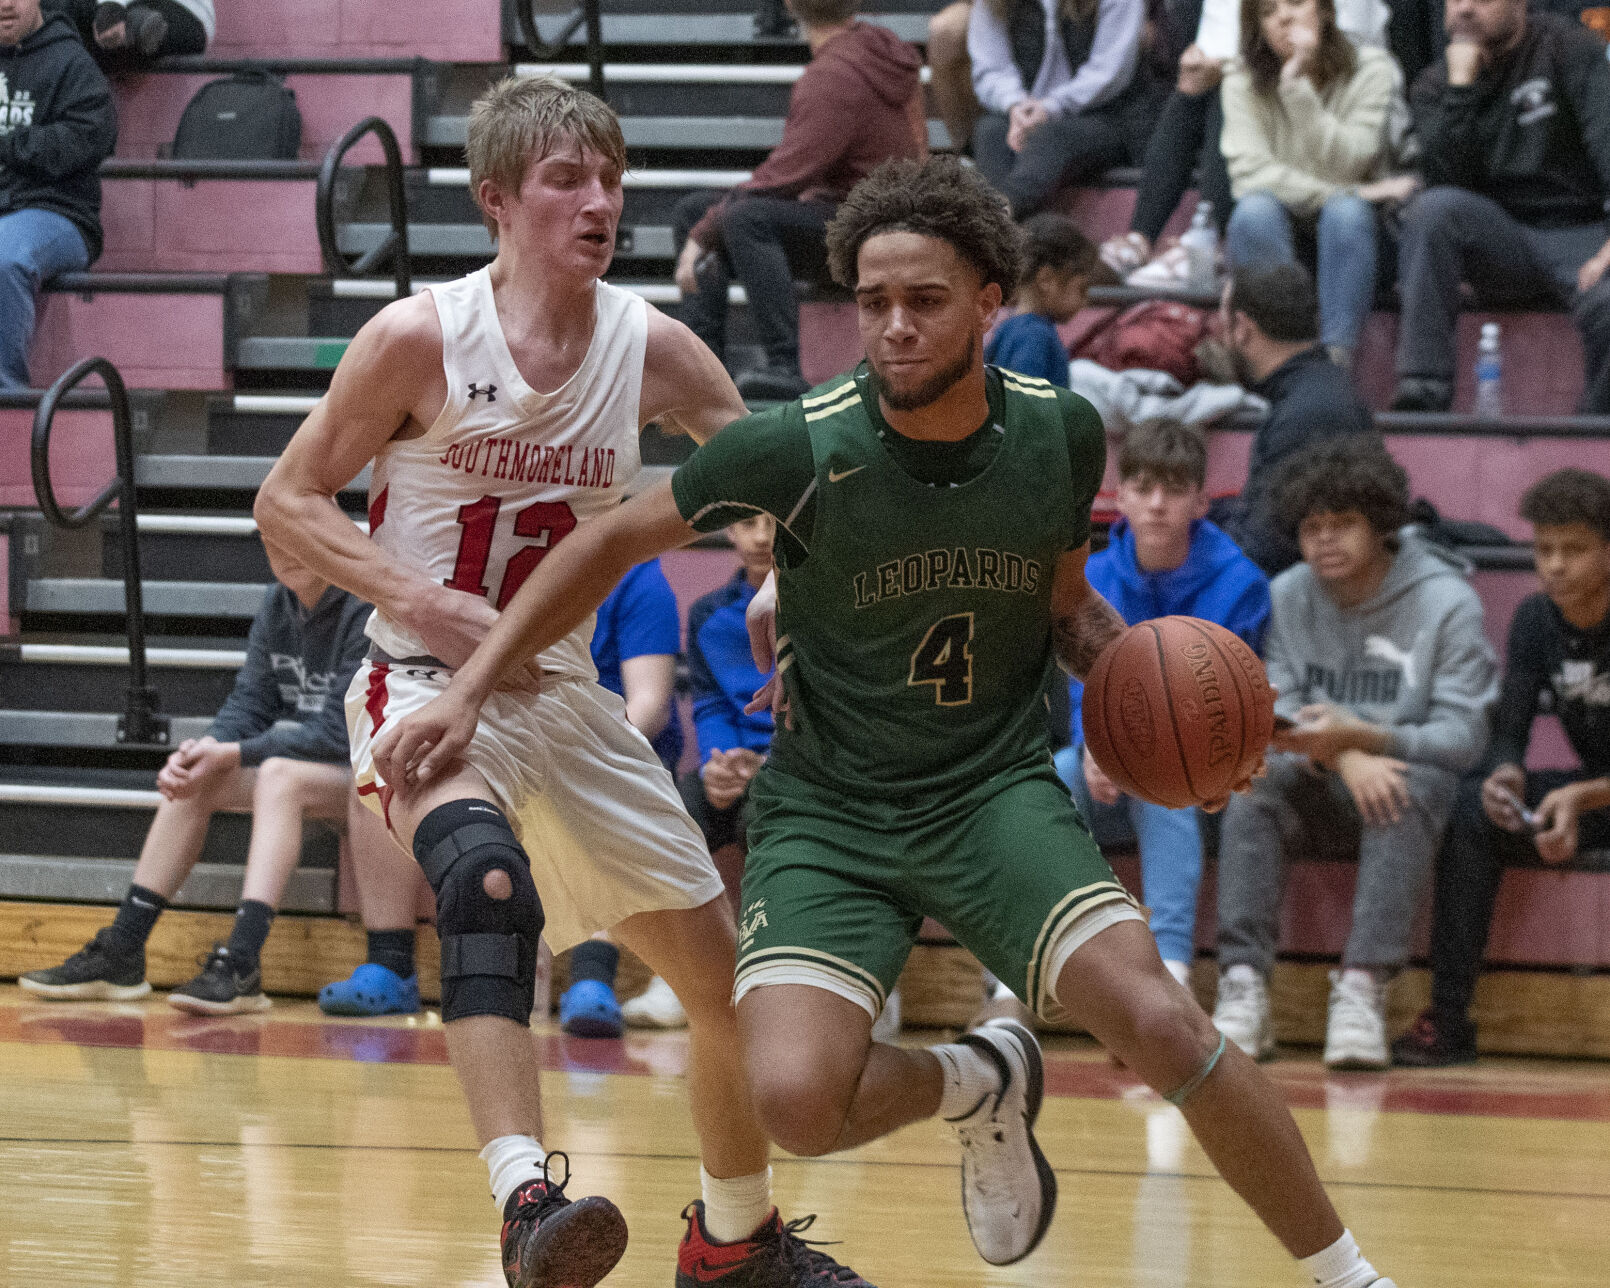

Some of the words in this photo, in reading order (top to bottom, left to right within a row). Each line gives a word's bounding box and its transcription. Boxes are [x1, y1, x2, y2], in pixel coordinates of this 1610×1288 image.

[439, 437, 616, 489] SOUTHMORELAND
[443, 494, 578, 613] 12
[853, 546, 1042, 609] LEOPARDS
[906, 611, 975, 707] 4
[1182, 643, 1233, 769] SPALDING
